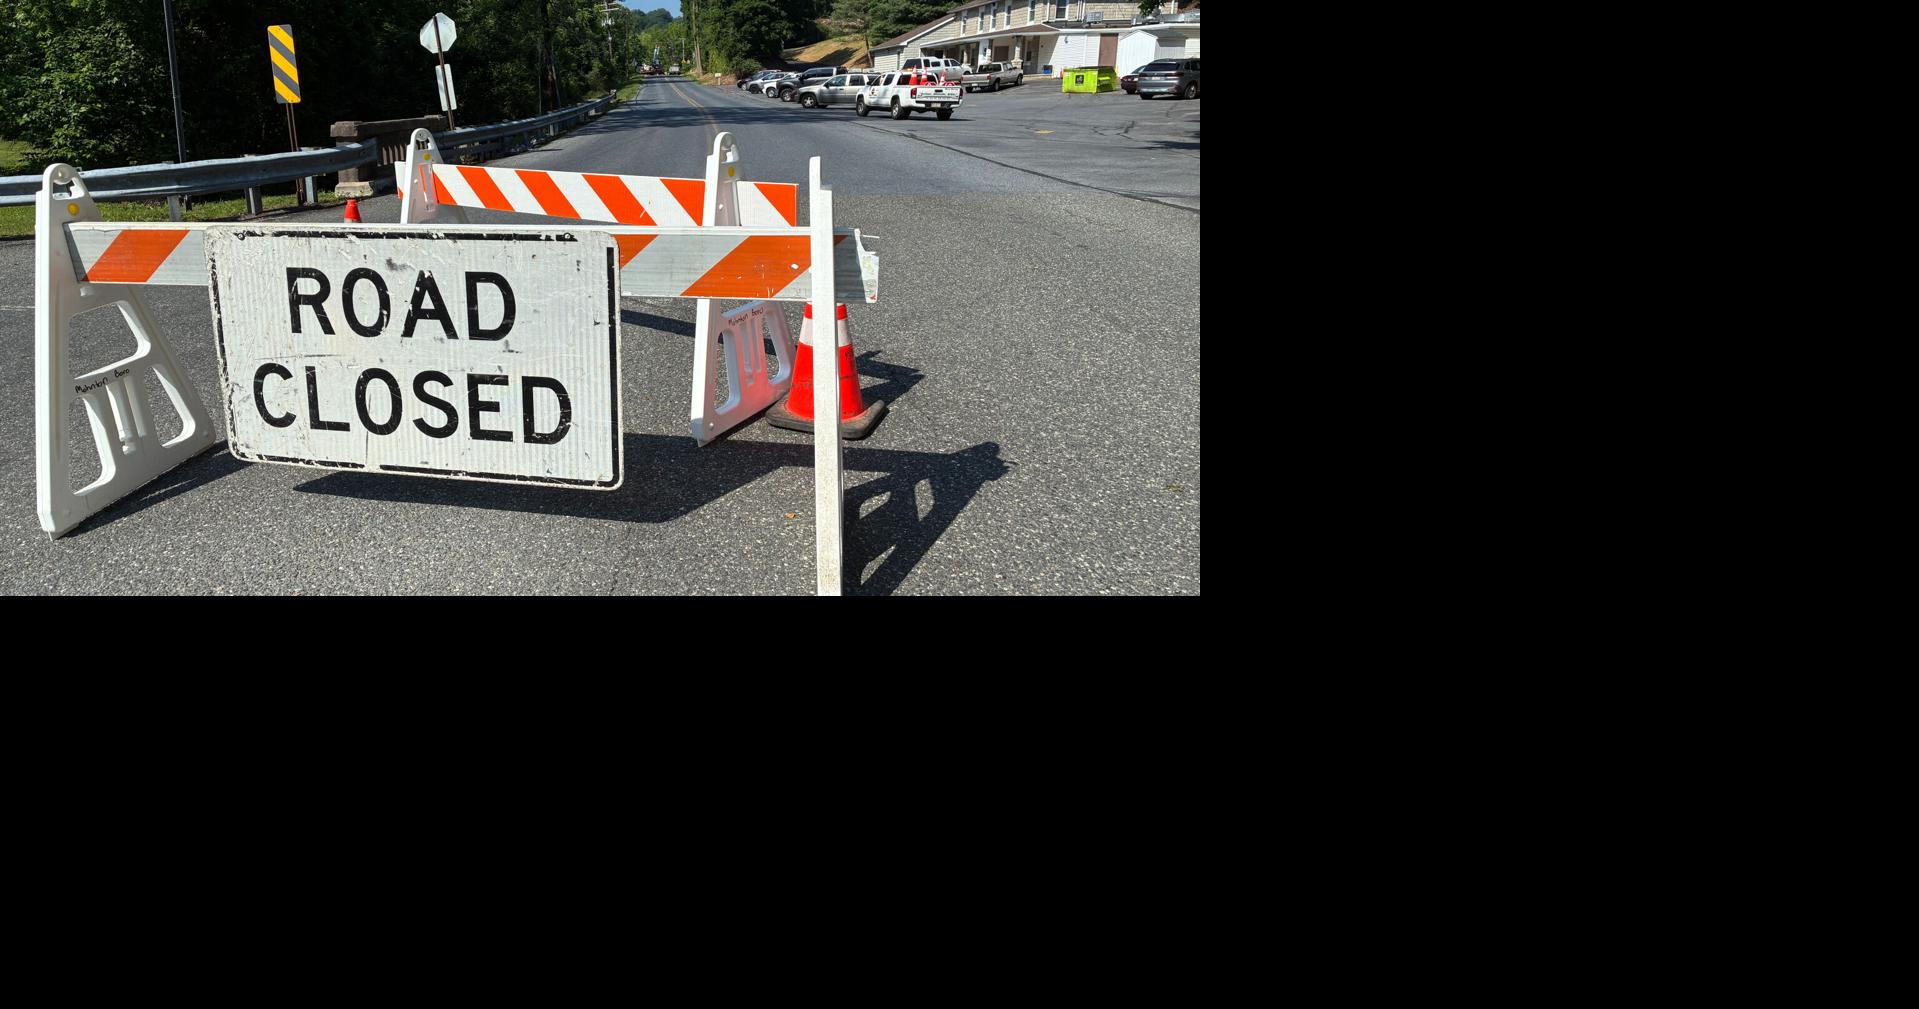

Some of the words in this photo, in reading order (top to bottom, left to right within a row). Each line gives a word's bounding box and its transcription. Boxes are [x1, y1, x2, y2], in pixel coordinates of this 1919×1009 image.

[286, 267, 516, 341] ROAD
[114, 368, 130, 378] Boro
[253, 363, 572, 445] CLOSED
